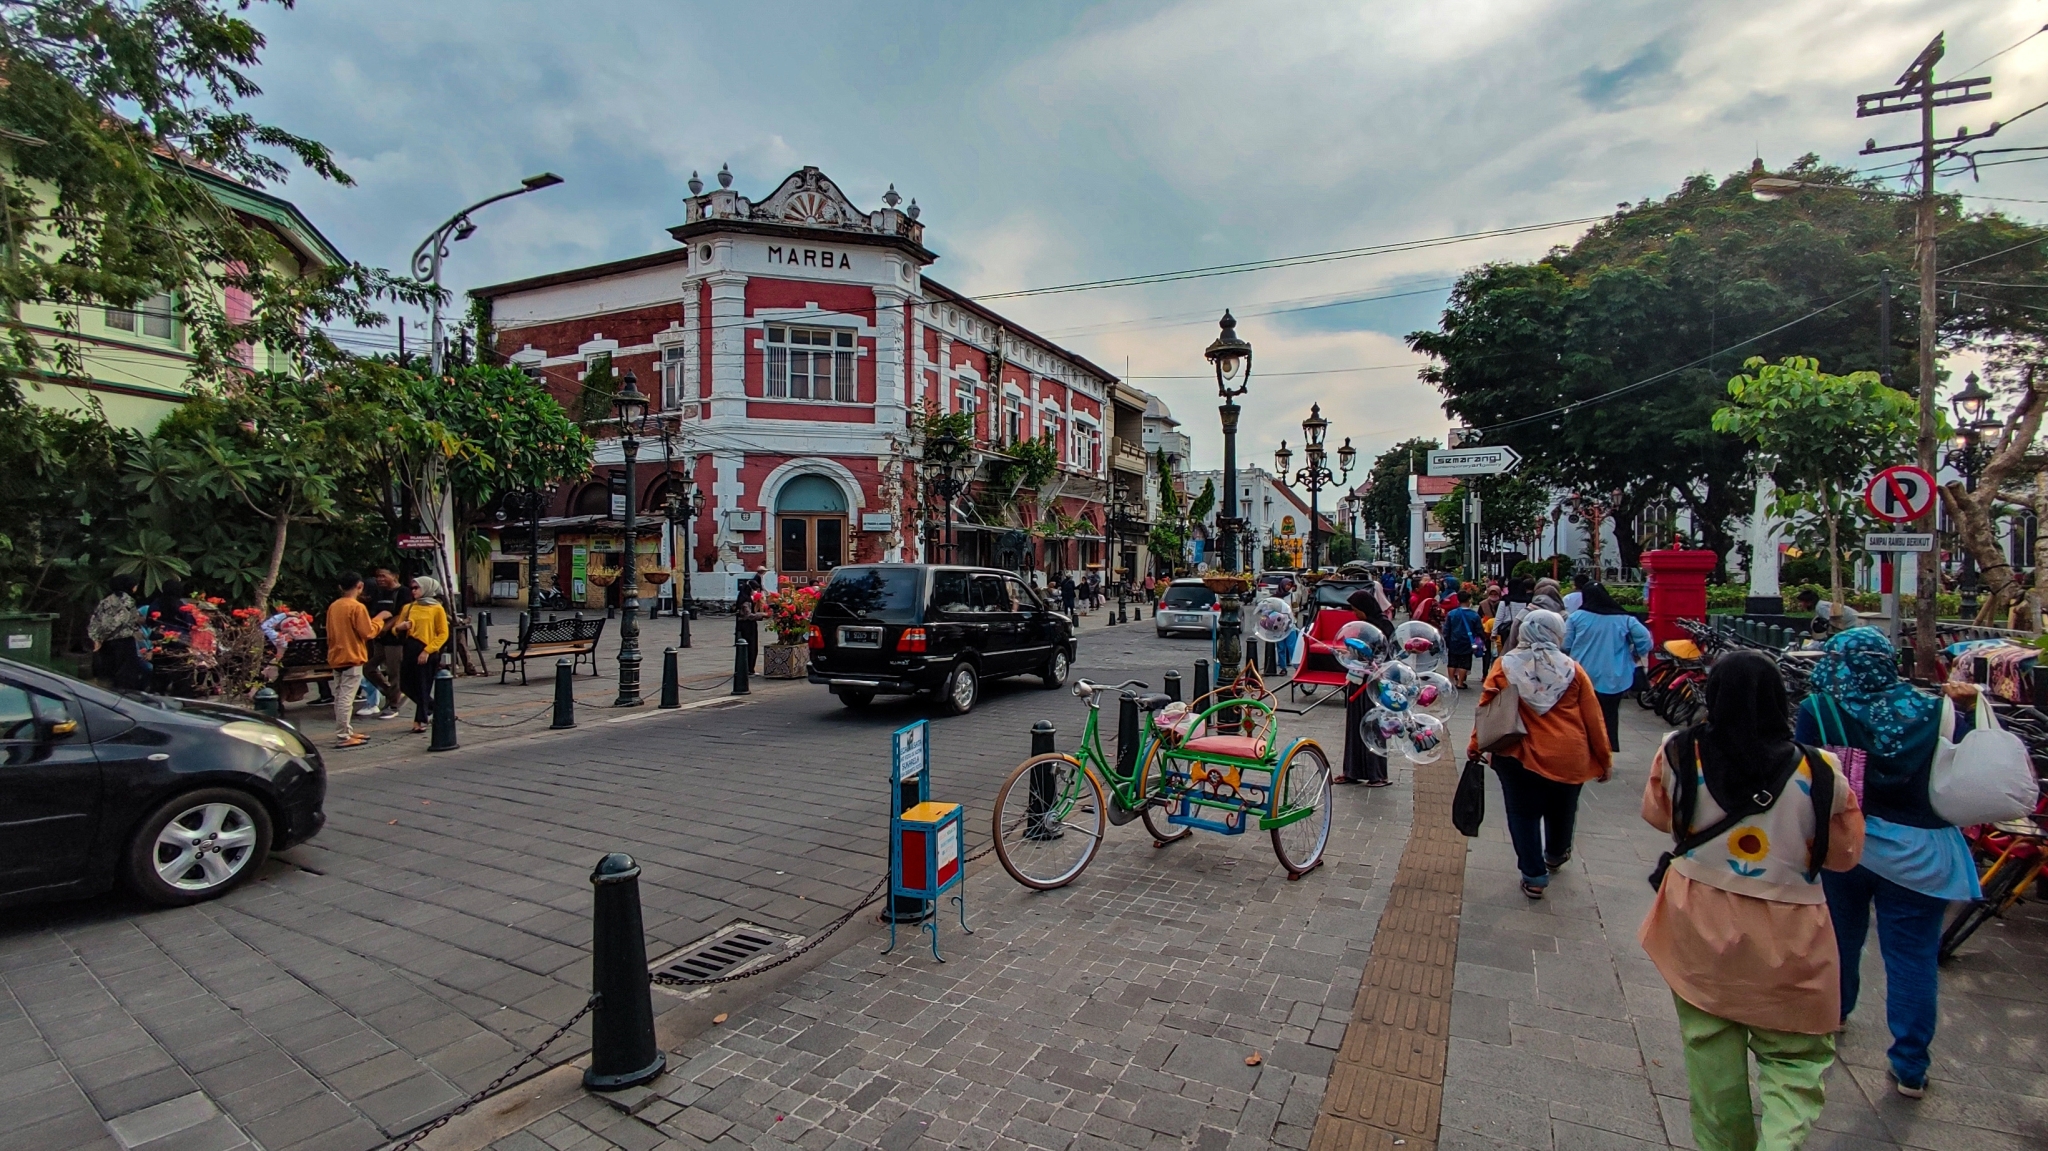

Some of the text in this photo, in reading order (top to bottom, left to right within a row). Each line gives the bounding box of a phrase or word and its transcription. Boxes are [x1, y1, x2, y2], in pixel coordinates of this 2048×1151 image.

[768, 246, 851, 269] MARBA
[1885, 478, 1917, 514] P
[1869, 537, 1930, 547] SAMPAI RAMBU BERIKUT
